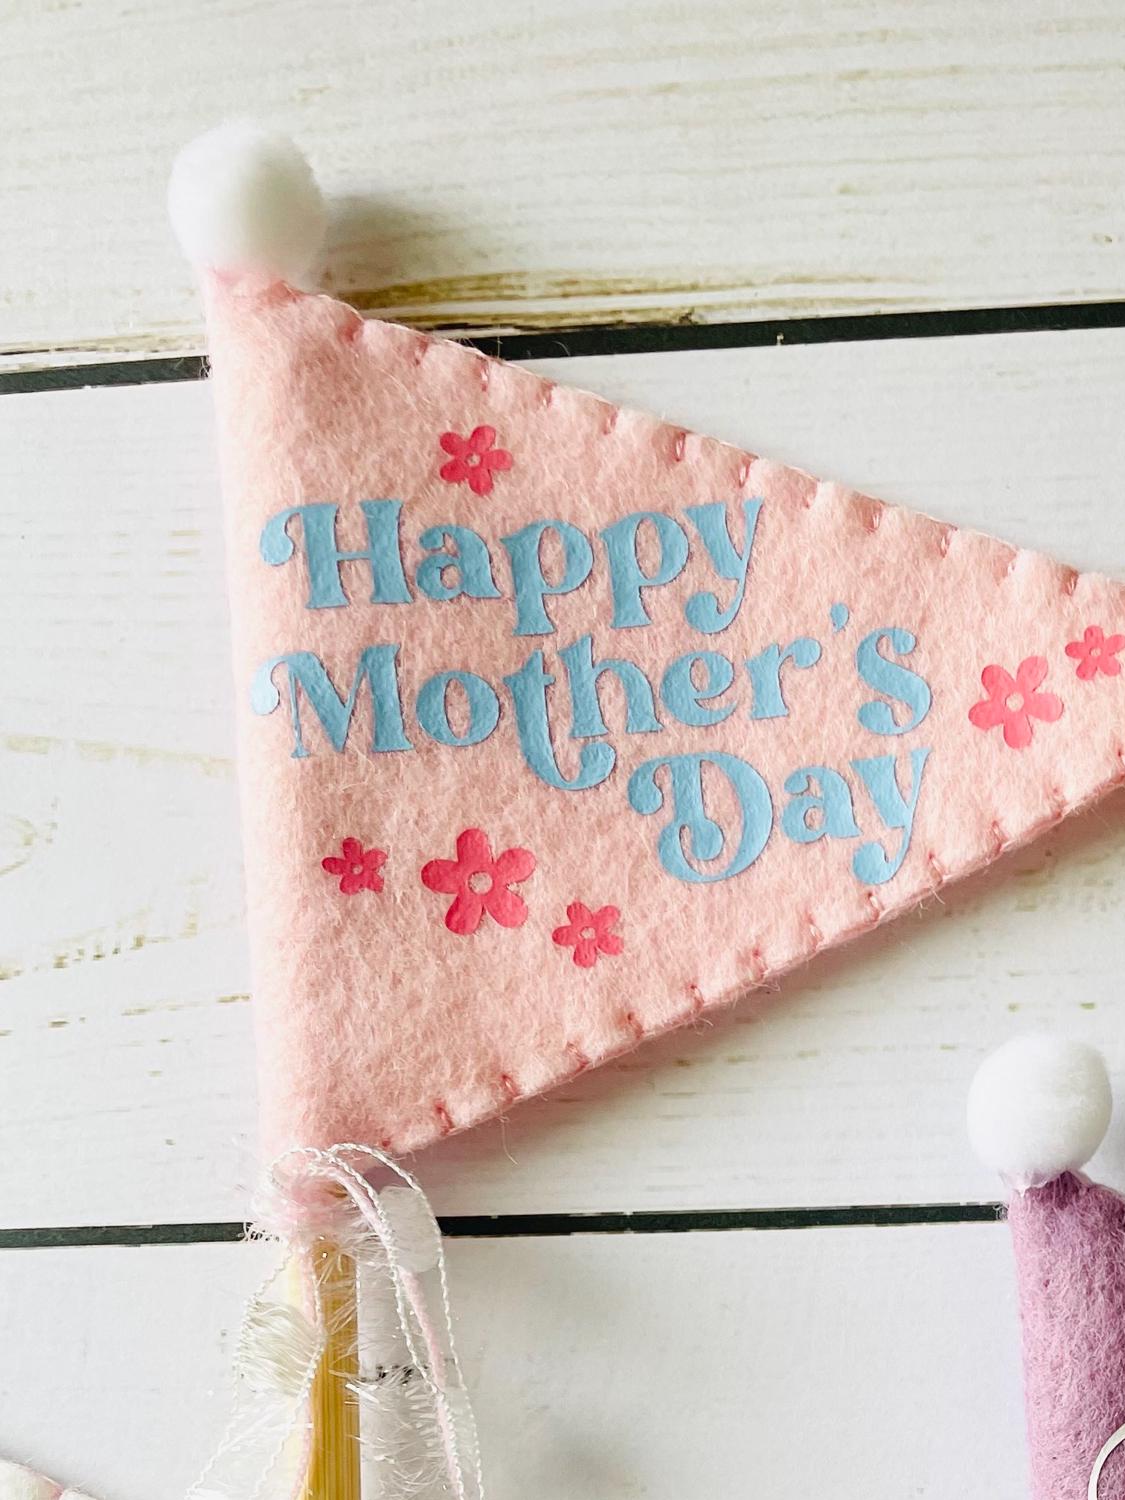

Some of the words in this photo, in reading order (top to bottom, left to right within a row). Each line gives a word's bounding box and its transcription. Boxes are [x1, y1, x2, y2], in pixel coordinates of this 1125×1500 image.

[258, 497, 765, 636] Happy
[250, 602, 933, 792] Mother's
[627, 747, 932, 886] Day
